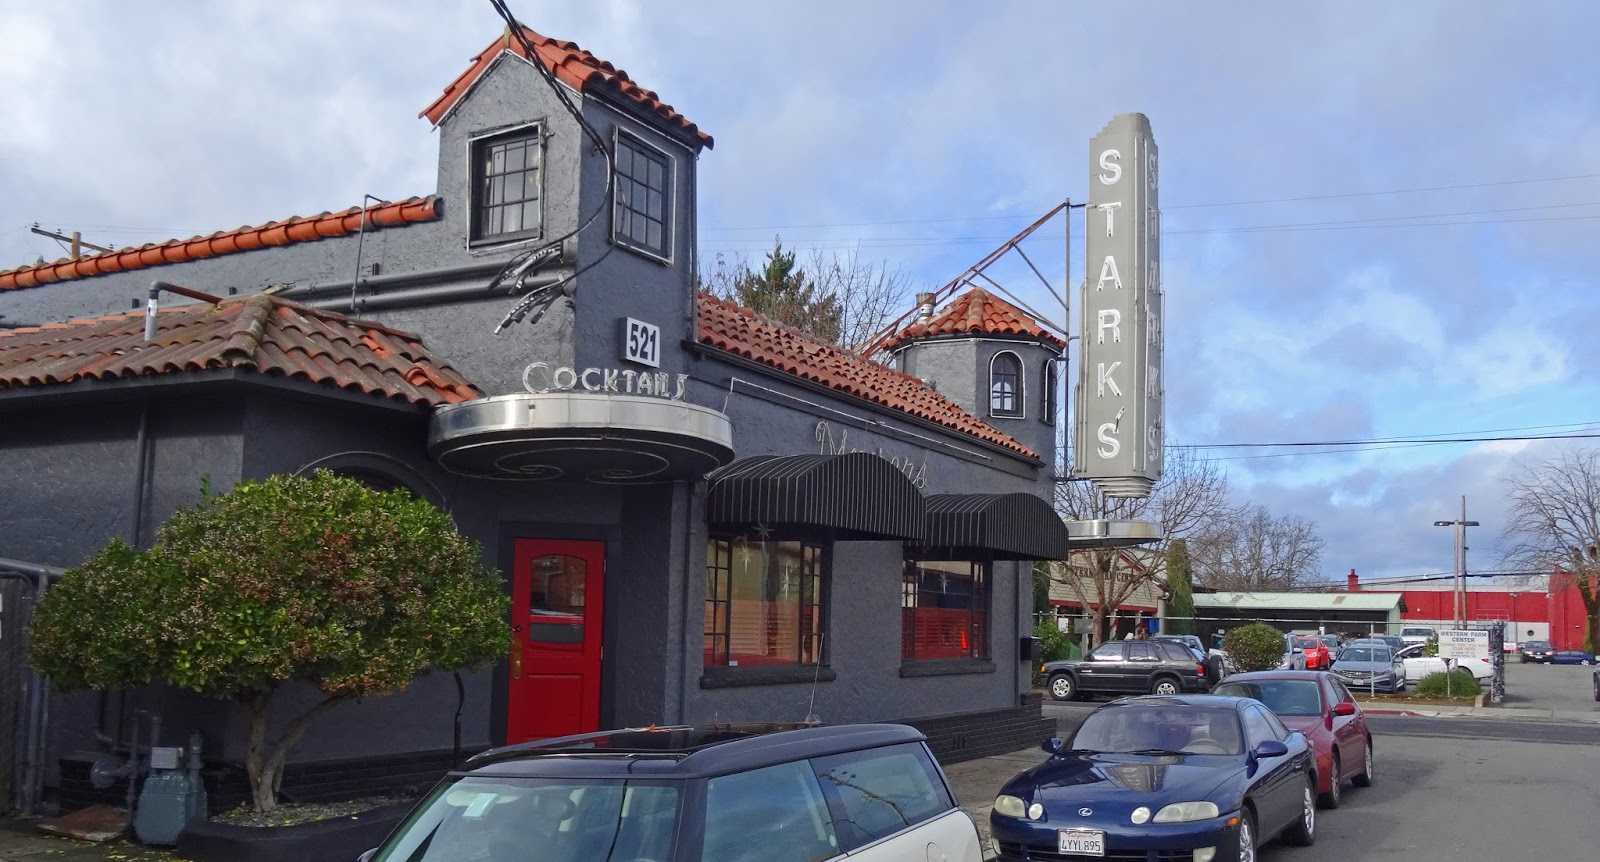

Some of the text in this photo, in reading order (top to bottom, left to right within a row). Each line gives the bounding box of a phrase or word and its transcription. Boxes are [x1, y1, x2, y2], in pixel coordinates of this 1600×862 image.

[1097, 149, 1125, 460] STARK'S
[629, 323, 657, 362] 521
[1061, 840, 1101, 851] 4YYL895
